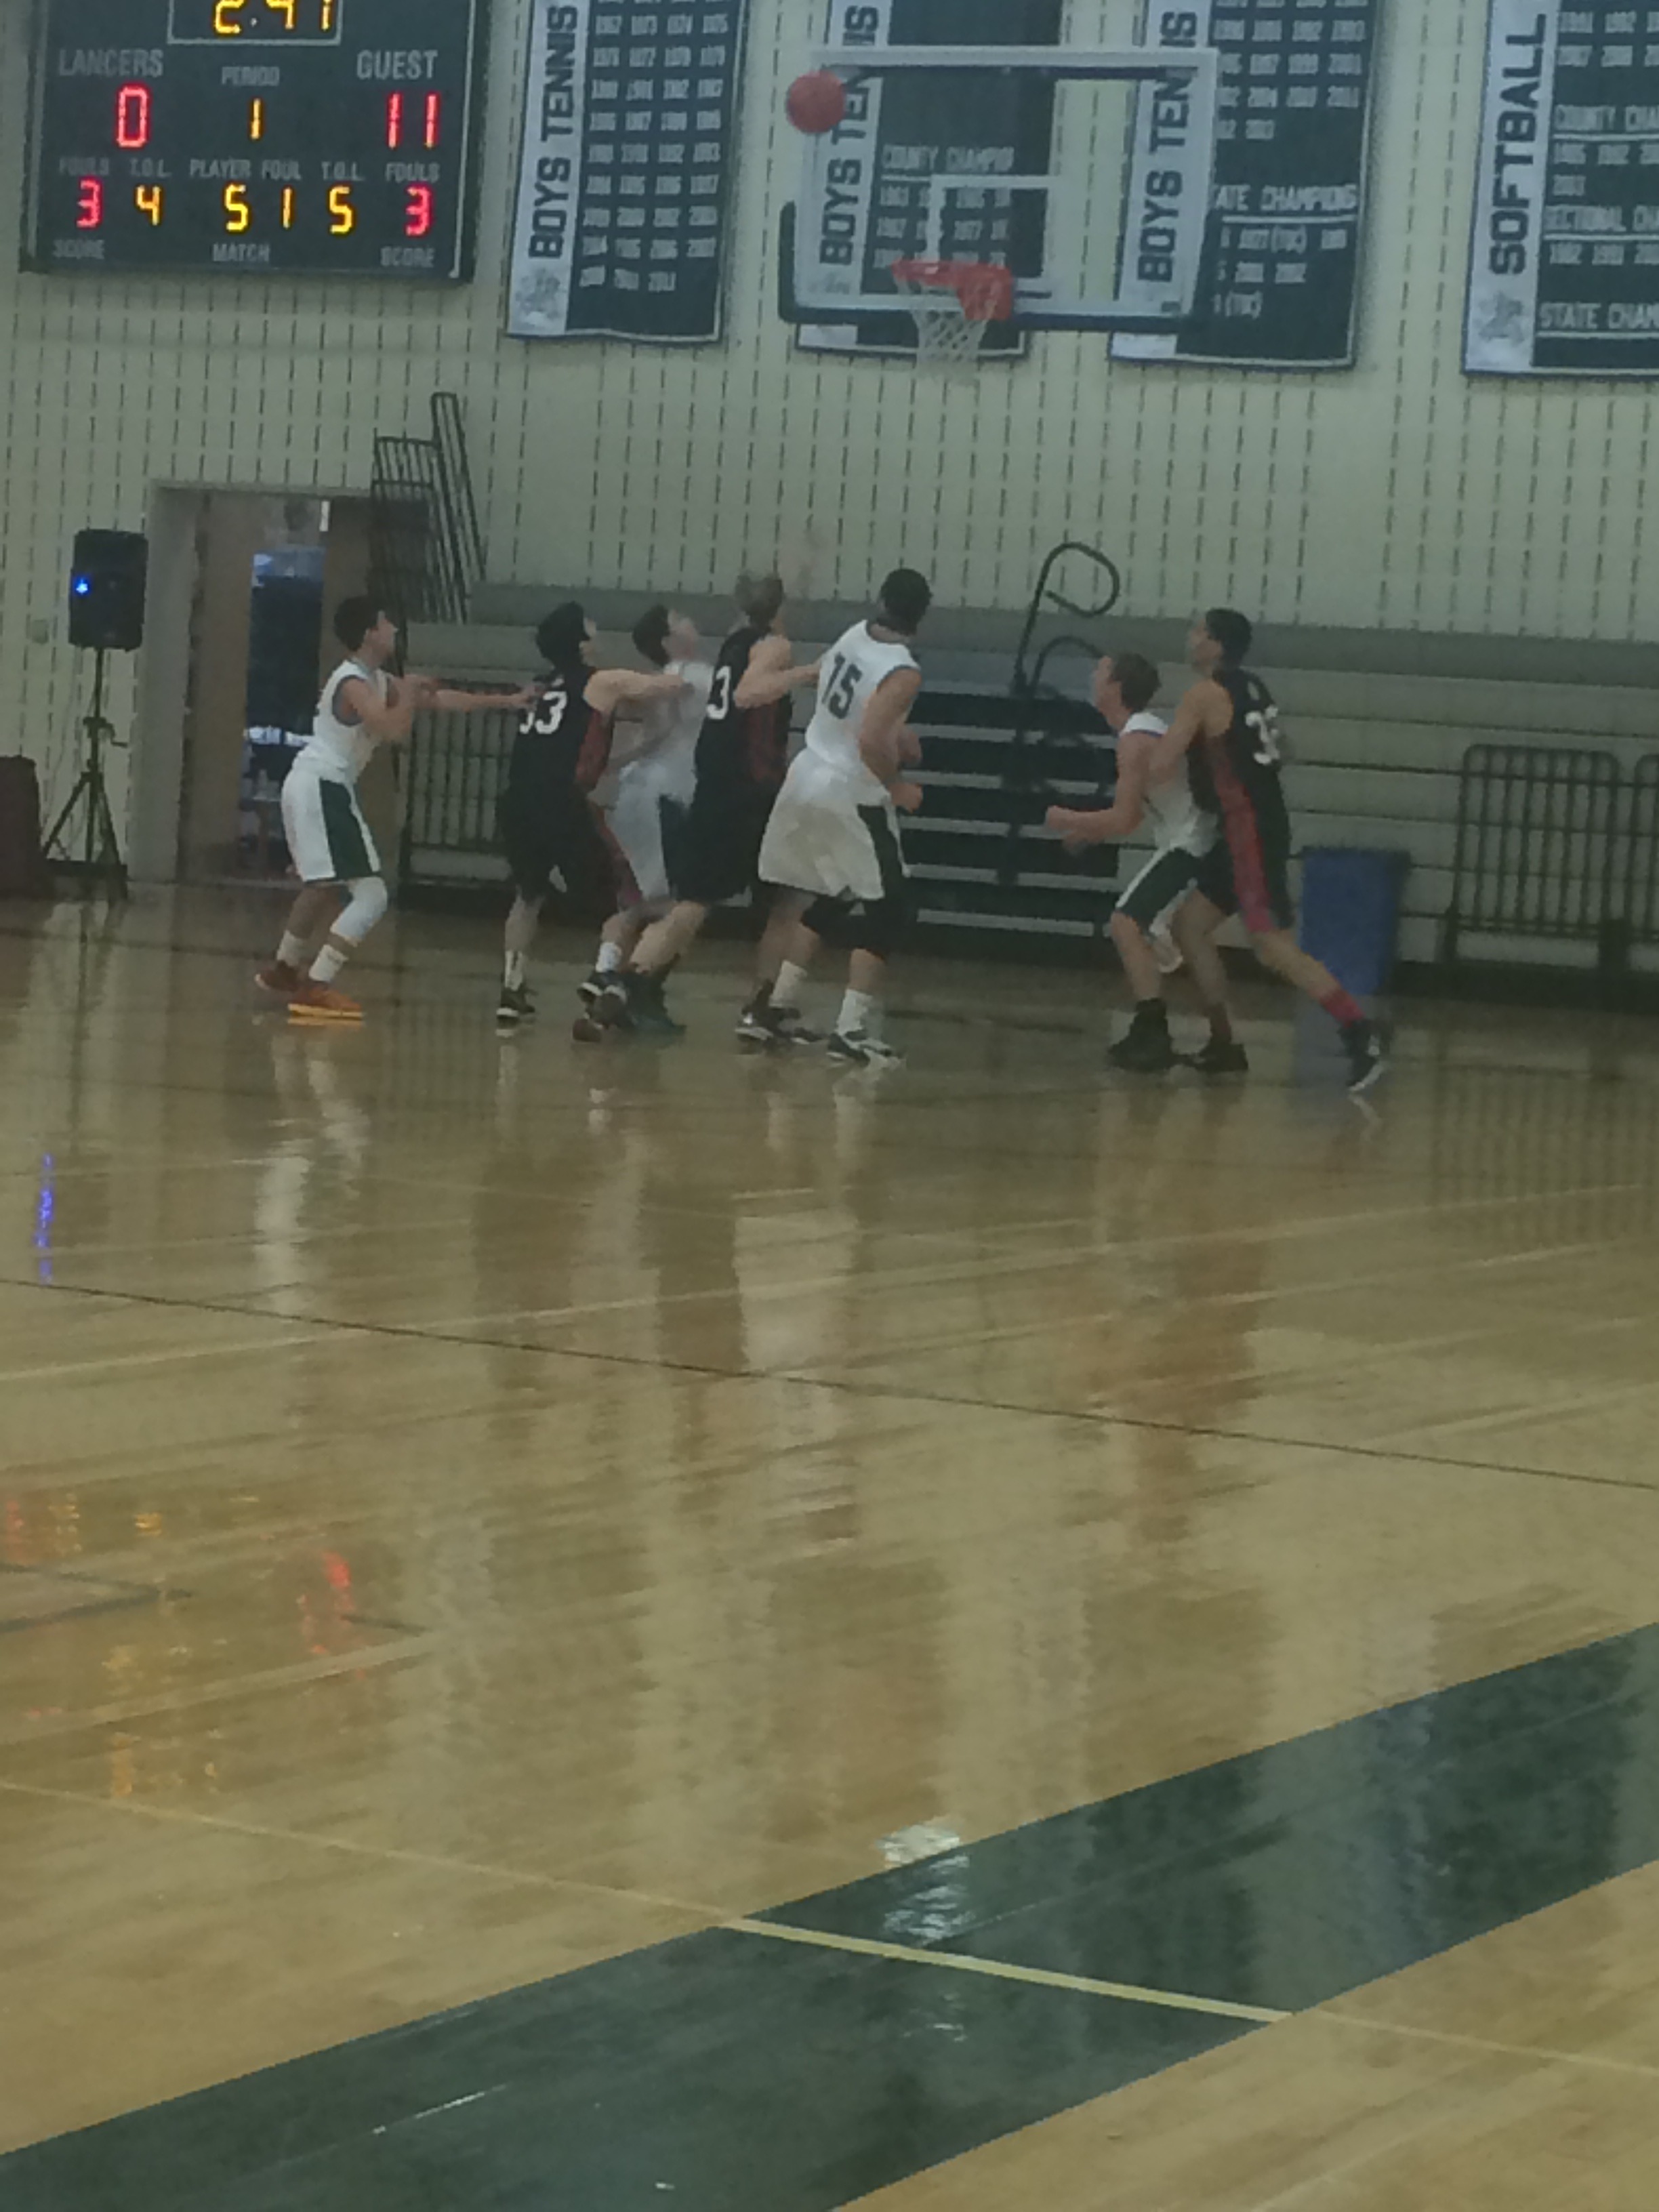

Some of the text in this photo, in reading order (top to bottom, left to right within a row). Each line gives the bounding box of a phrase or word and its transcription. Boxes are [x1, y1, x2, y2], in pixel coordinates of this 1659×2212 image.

[58, 49, 164, 77] LANCERS
[222, 66, 281, 87] PERIOD
[356, 49, 438, 80] GUEST
[116, 85, 149, 148] 0
[386, 92, 437, 148] 11
[528, 5, 578, 259] BOYS TENNIS
[1490, 13, 1547, 274] SOFTBALL
[189, 158, 302, 181] PLAYER FOUL
[385, 162, 441, 182] FOULS
[76, 178, 102, 228] 3
[136, 184, 163, 226] 4
[329, 185, 353, 234] 5
[406, 185, 432, 236] 3
[819, 157, 861, 266] BOYS
[1136, 170, 1183, 283] BOYS
[212, 243, 270, 262] MATCH
[380, 245, 435, 268] SCORE
[1540, 302, 1601, 329] STATE
[822, 651, 863, 719] 15
